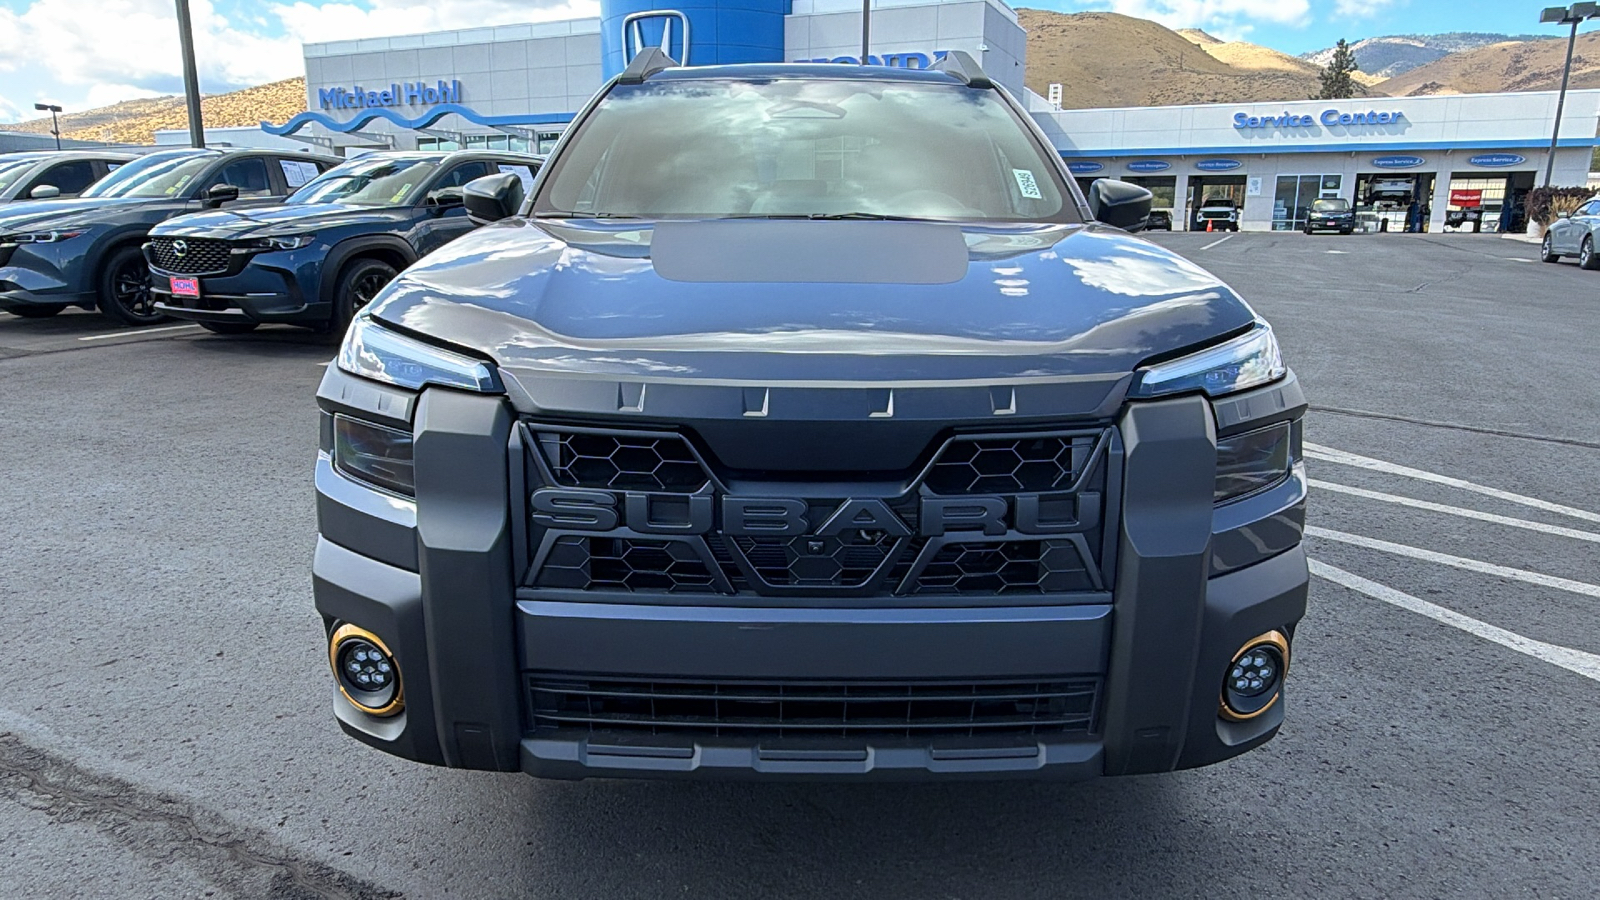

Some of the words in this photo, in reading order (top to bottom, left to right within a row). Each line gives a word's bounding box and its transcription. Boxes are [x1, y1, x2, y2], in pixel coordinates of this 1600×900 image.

[318, 83, 400, 109] Michael
[403, 79, 460, 104] Hohl
[1233, 111, 1313, 129] Service
[1320, 109, 1403, 126] Center
[173, 281, 195, 290] HOHL
[531, 486, 1101, 536] SUBARU
